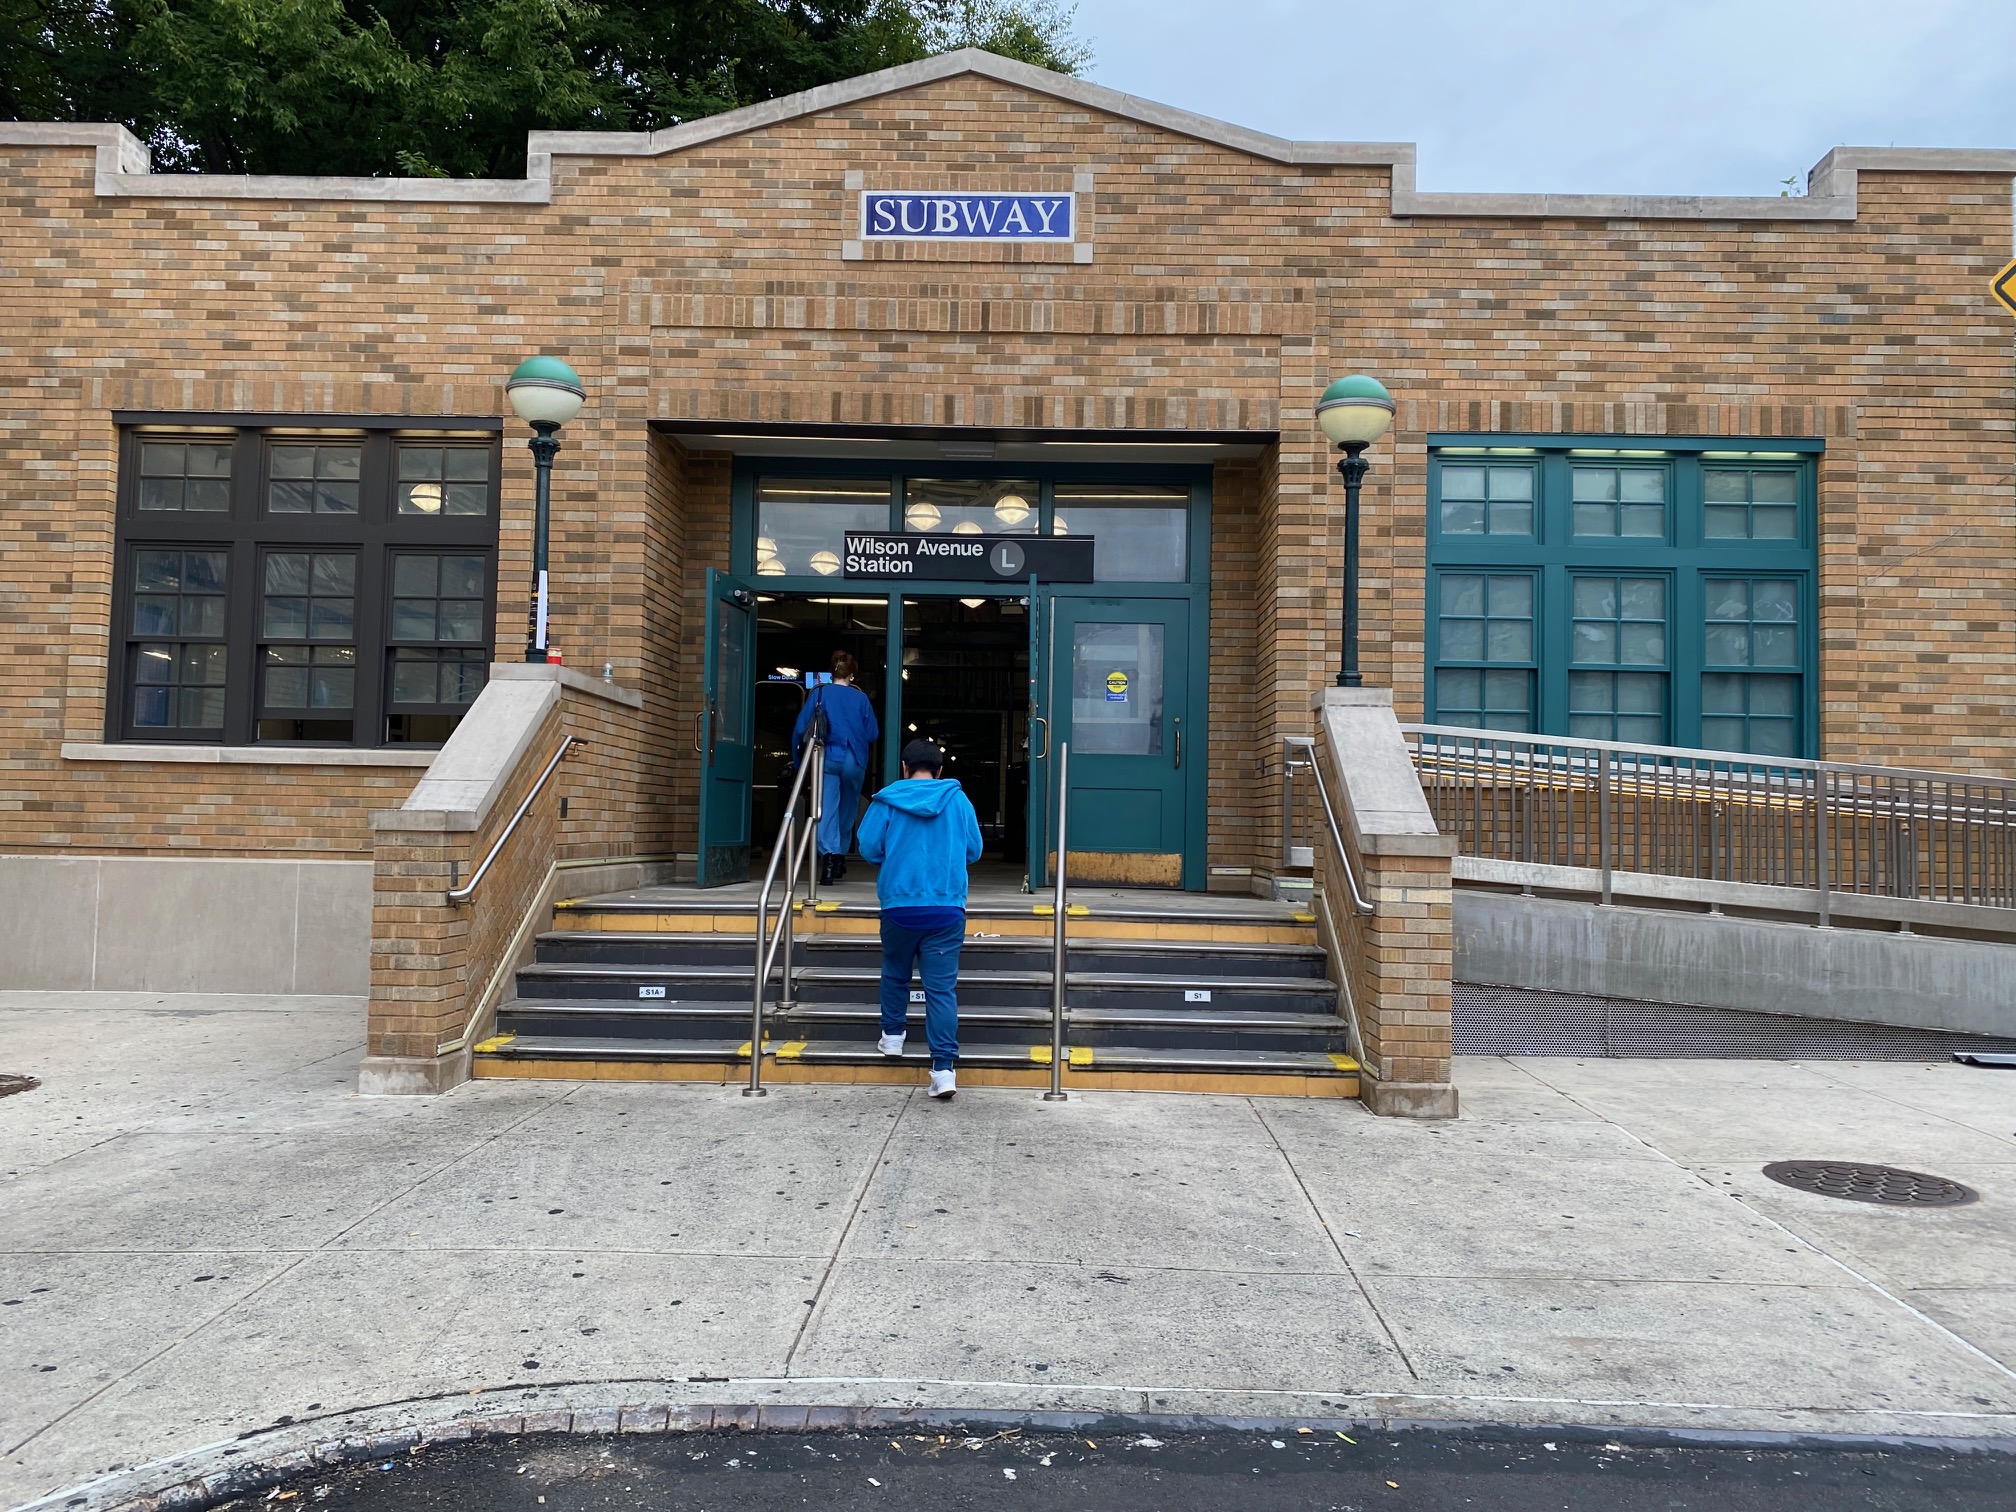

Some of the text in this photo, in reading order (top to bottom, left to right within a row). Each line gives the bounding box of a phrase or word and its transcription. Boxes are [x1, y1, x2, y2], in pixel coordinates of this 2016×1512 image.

[873, 198, 1064, 234] SUBWAY
[845, 555, 913, 574] Station
[846, 537, 1016, 568] Wilson Avenue L
